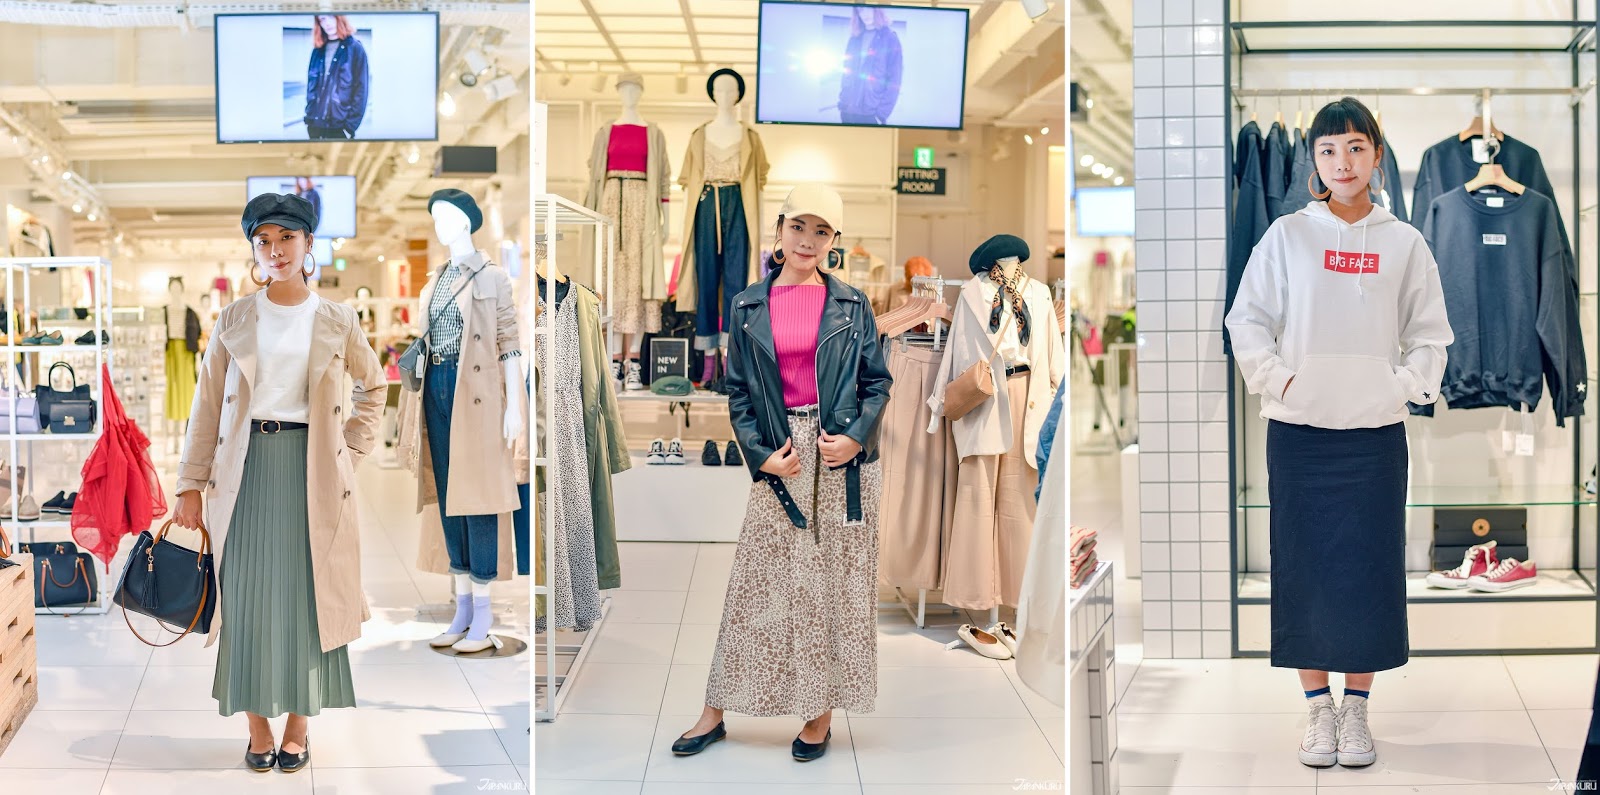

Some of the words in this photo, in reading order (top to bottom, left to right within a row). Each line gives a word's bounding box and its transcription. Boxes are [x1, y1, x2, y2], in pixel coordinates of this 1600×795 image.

[898, 169, 939, 180] FITTING
[902, 181, 936, 192] ROOM
[1349, 257, 1374, 269] FACE
[657, 356, 678, 365] NEW
